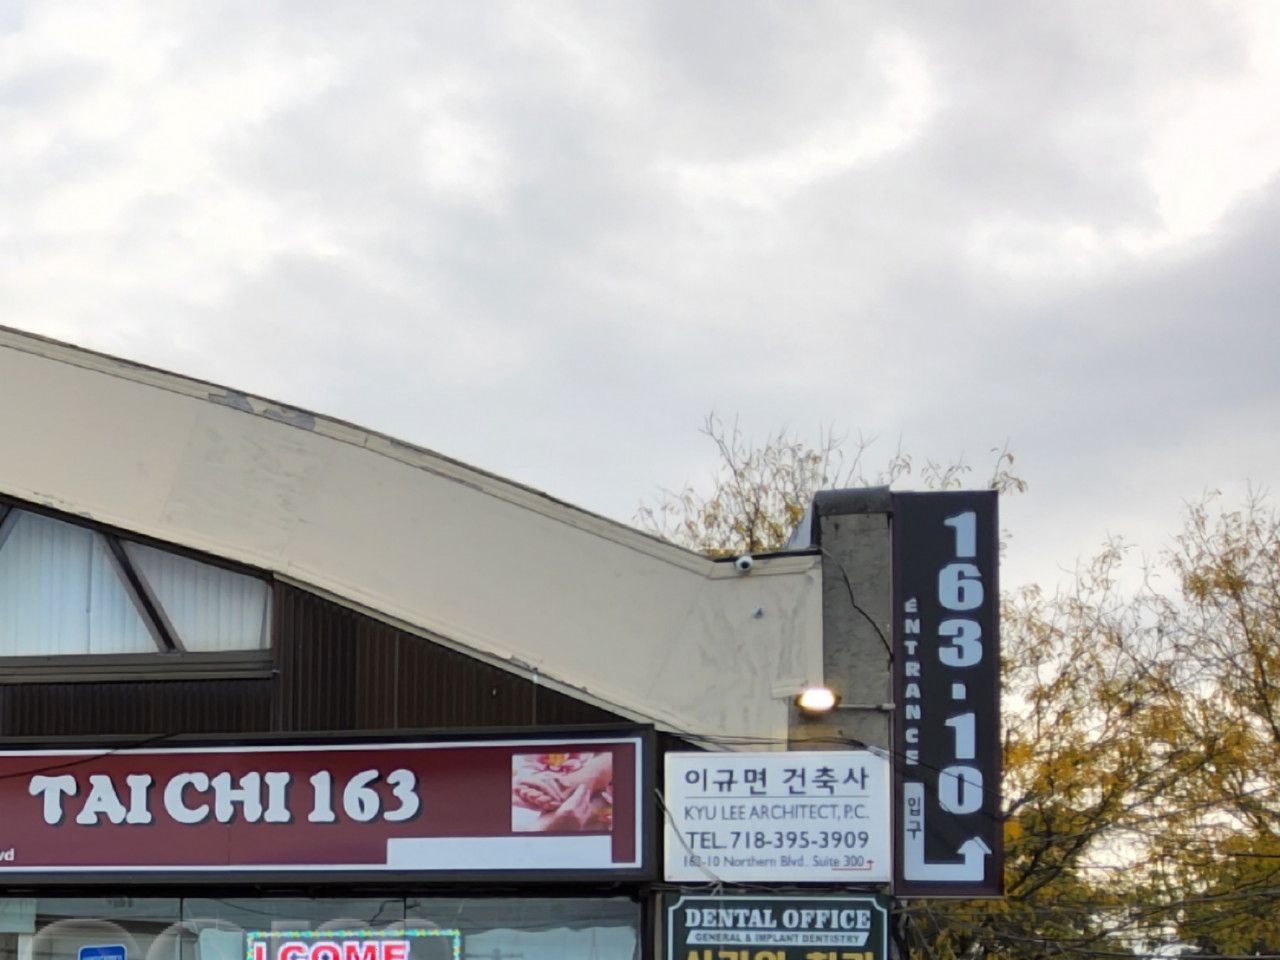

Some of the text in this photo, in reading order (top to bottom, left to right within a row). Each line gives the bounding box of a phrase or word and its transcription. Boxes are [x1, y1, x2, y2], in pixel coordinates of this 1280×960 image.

[904, 598, 921, 765] ENTRANCE
[685, 766, 869, 795] 이규면 건축사
[29, 768, 420, 826] TAI CHI 163
[684, 804, 869, 821] KYU LEE ARCHITECT, P.C.
[724, 856, 775, 867] Northern
[813, 856, 840, 867] Suite
[843, 855, 864, 867] 300
[685, 908, 870, 929] DENTAL OFFICE
[695, 933, 860, 944] GENERAL & IMPLANT DENTISTRY
